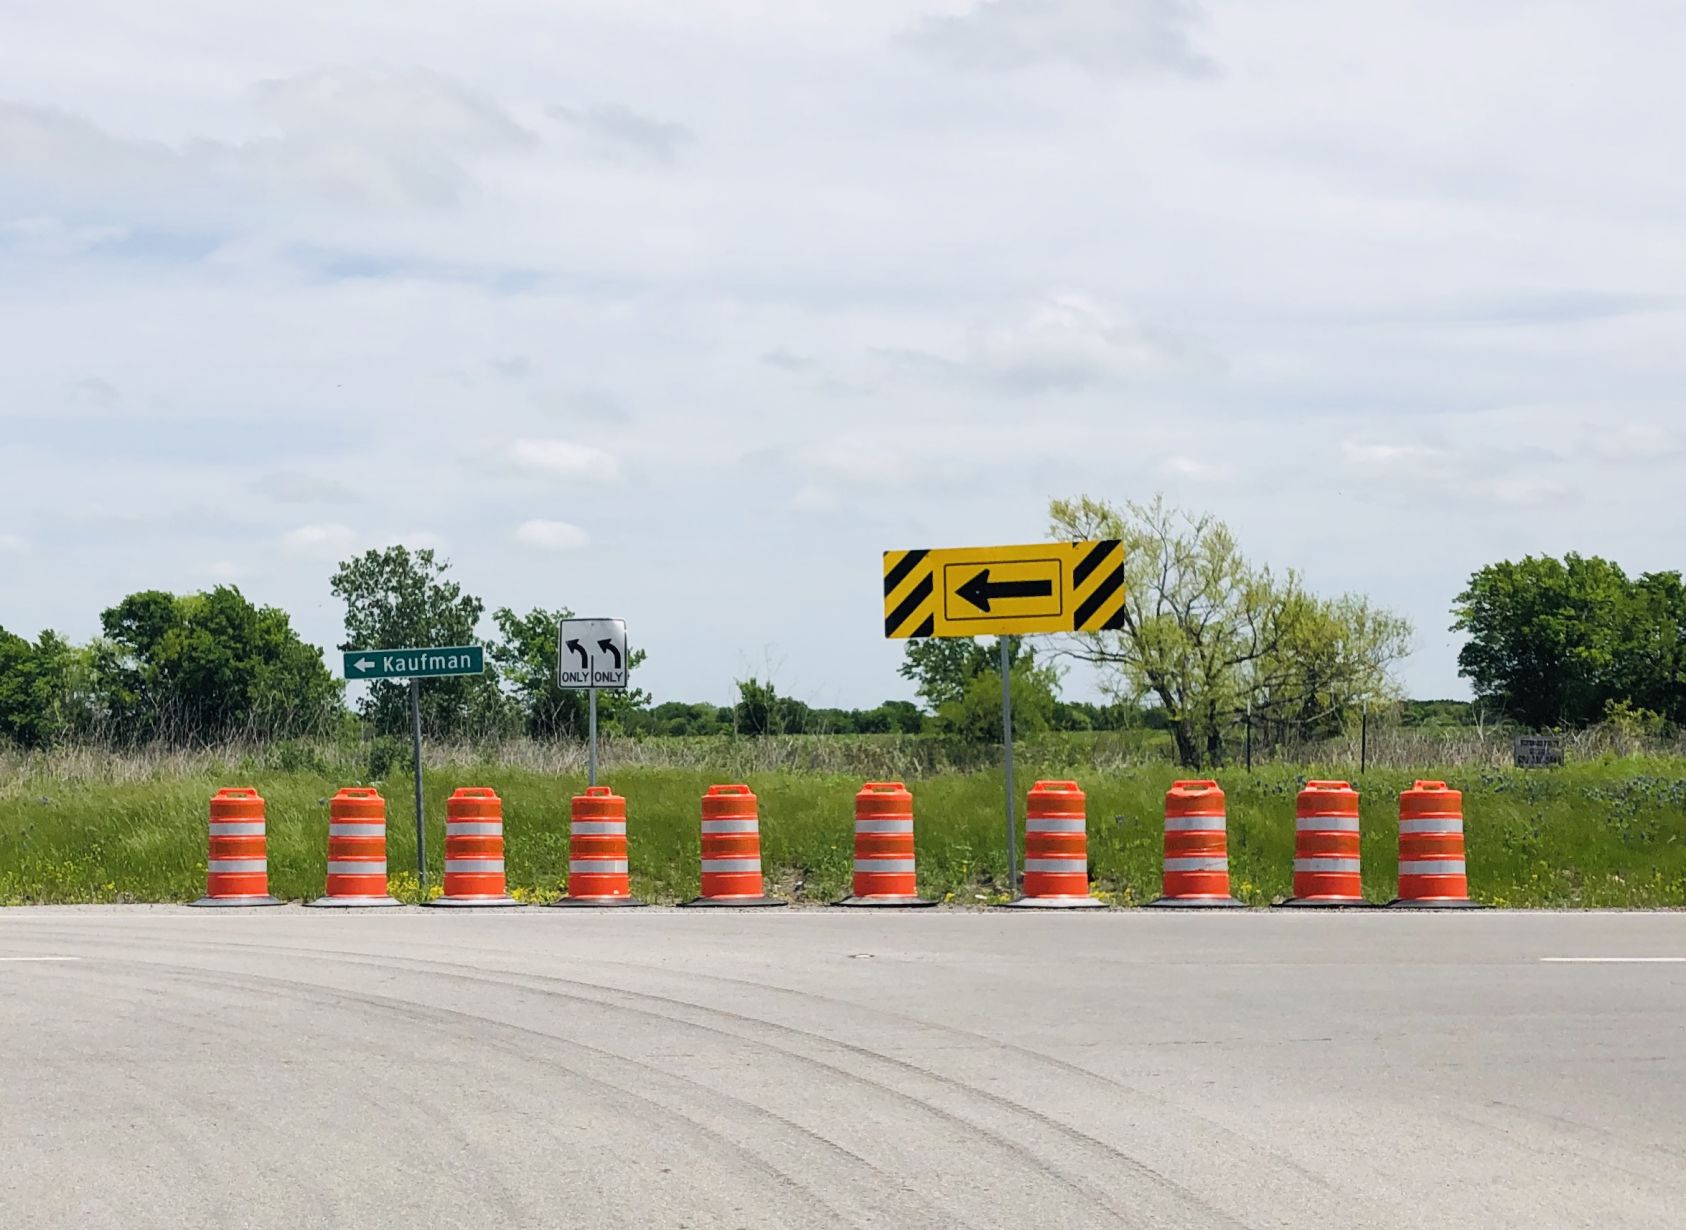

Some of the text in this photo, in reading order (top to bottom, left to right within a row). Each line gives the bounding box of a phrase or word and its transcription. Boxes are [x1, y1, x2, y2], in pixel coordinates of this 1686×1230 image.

[383, 653, 471, 673] Kaufman
[561, 671, 623, 683] ONLY ONLY
